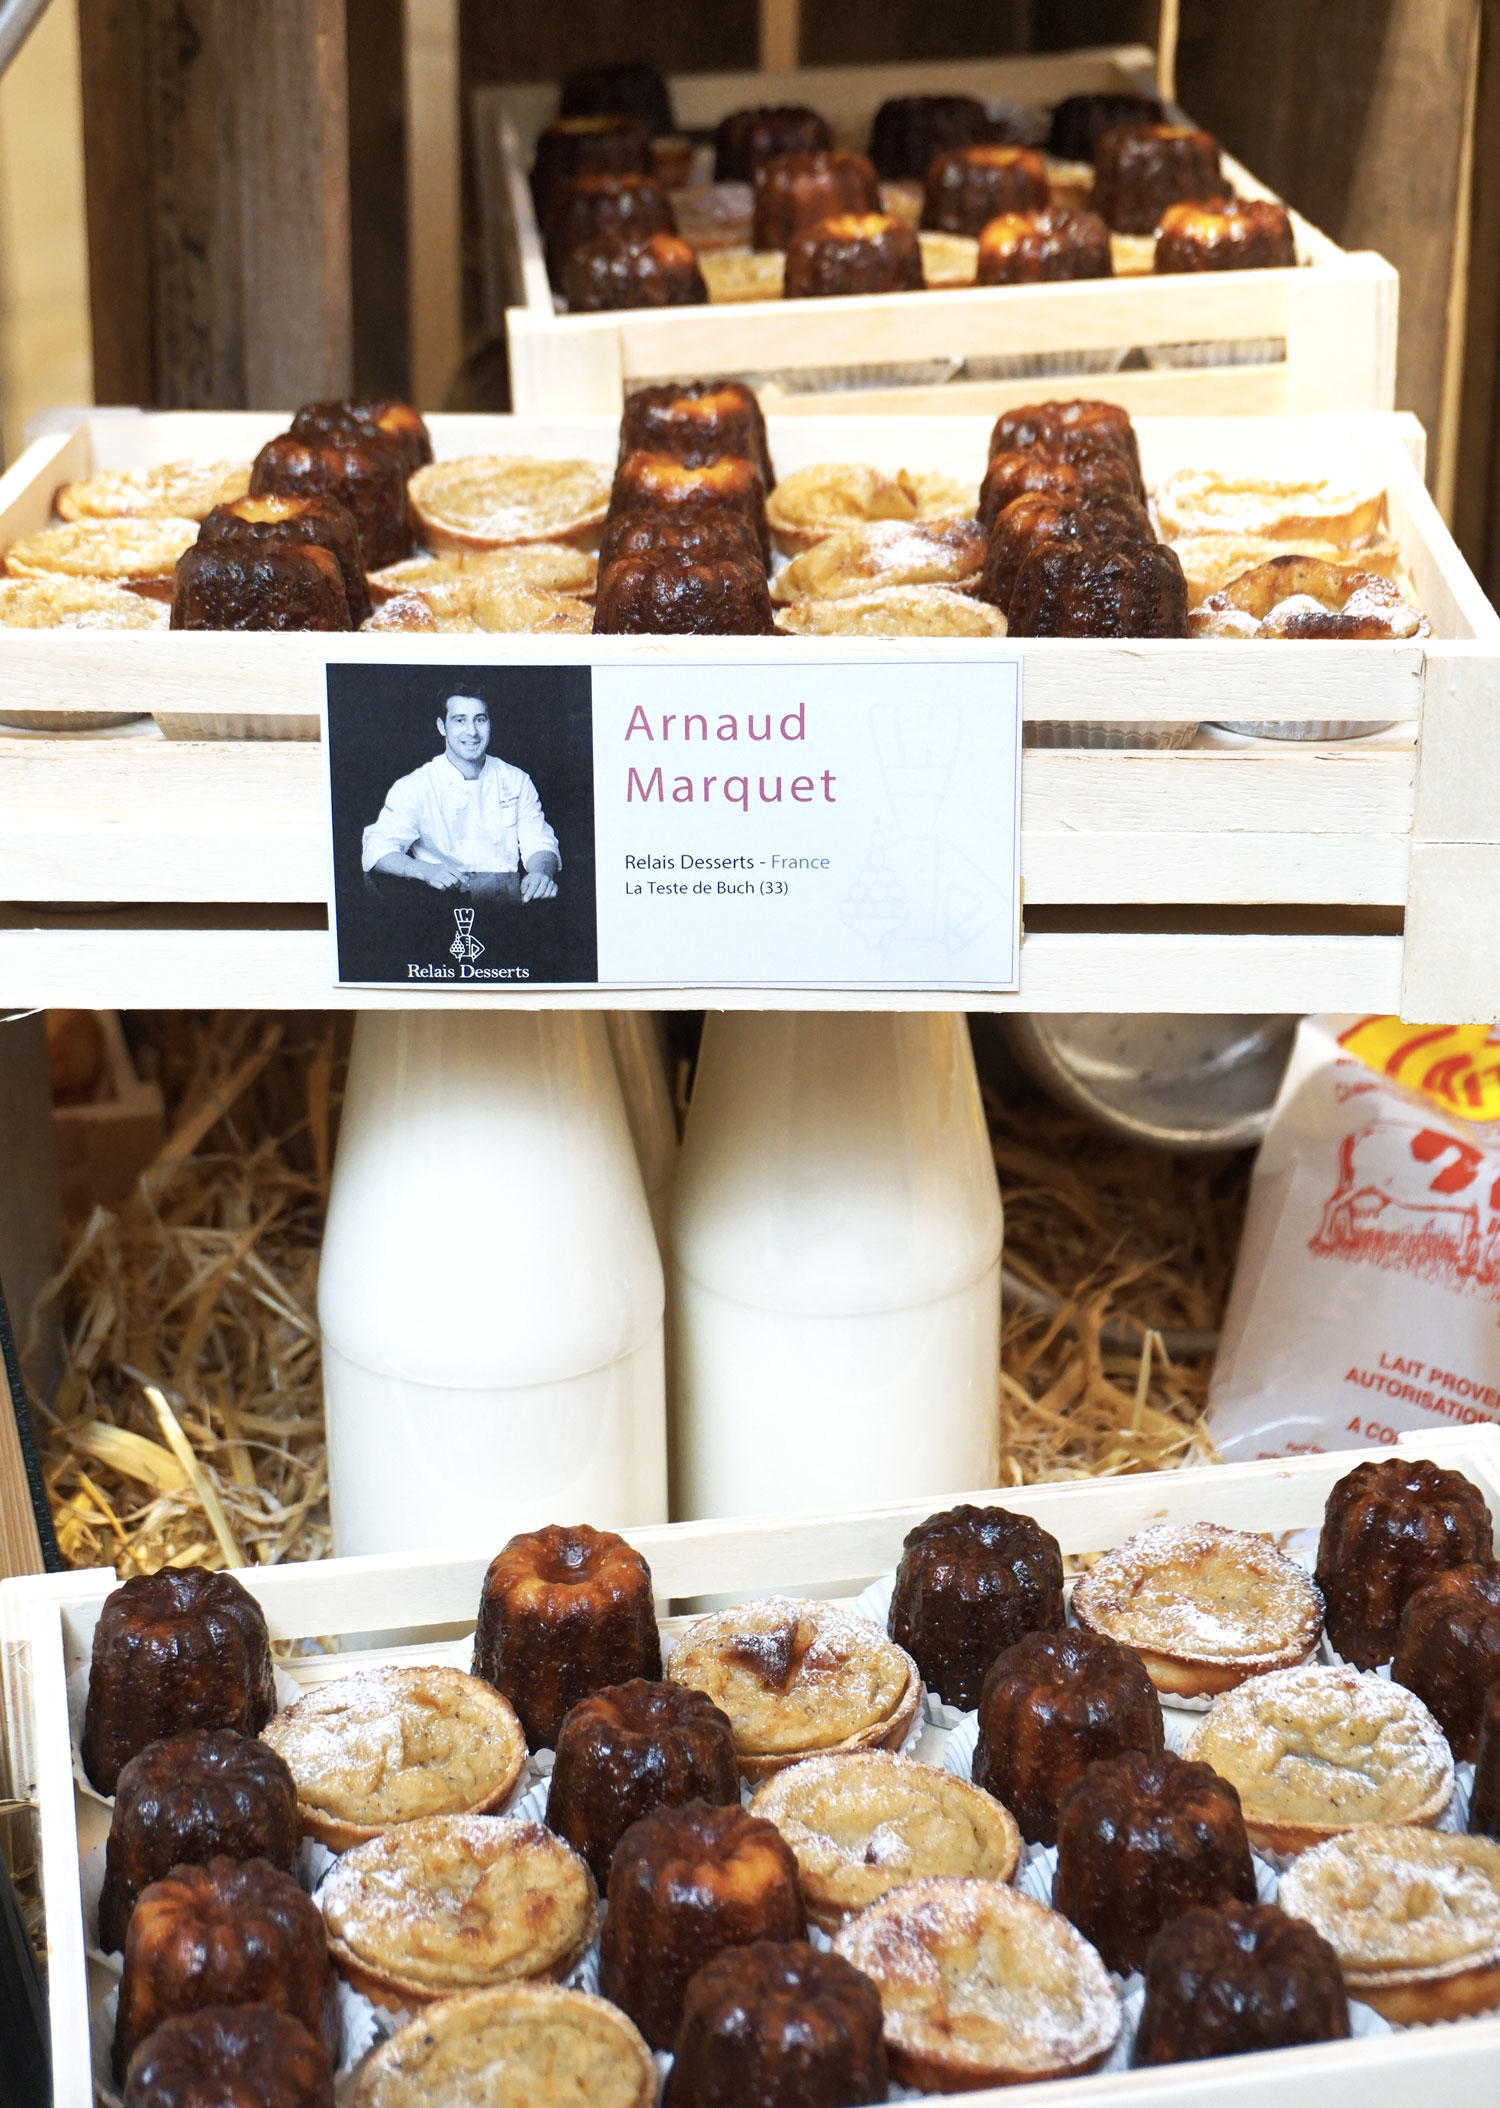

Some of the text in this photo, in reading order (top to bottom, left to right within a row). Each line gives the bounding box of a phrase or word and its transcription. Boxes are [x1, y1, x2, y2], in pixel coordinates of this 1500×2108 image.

[625, 703, 805, 741] Arnaud
[627, 767, 837, 812] Marquet
[625, 854, 675, 869] Relais
[681, 854, 755, 869] Desserts
[771, 854, 831, 869] France
[625, 881, 789, 896] La Teste de Buch (33)
[407, 964, 530, 978] Relais Desserts
[1378, 1352, 1425, 1378] LAIT
[1346, 1416, 1399, 1445] A CO
